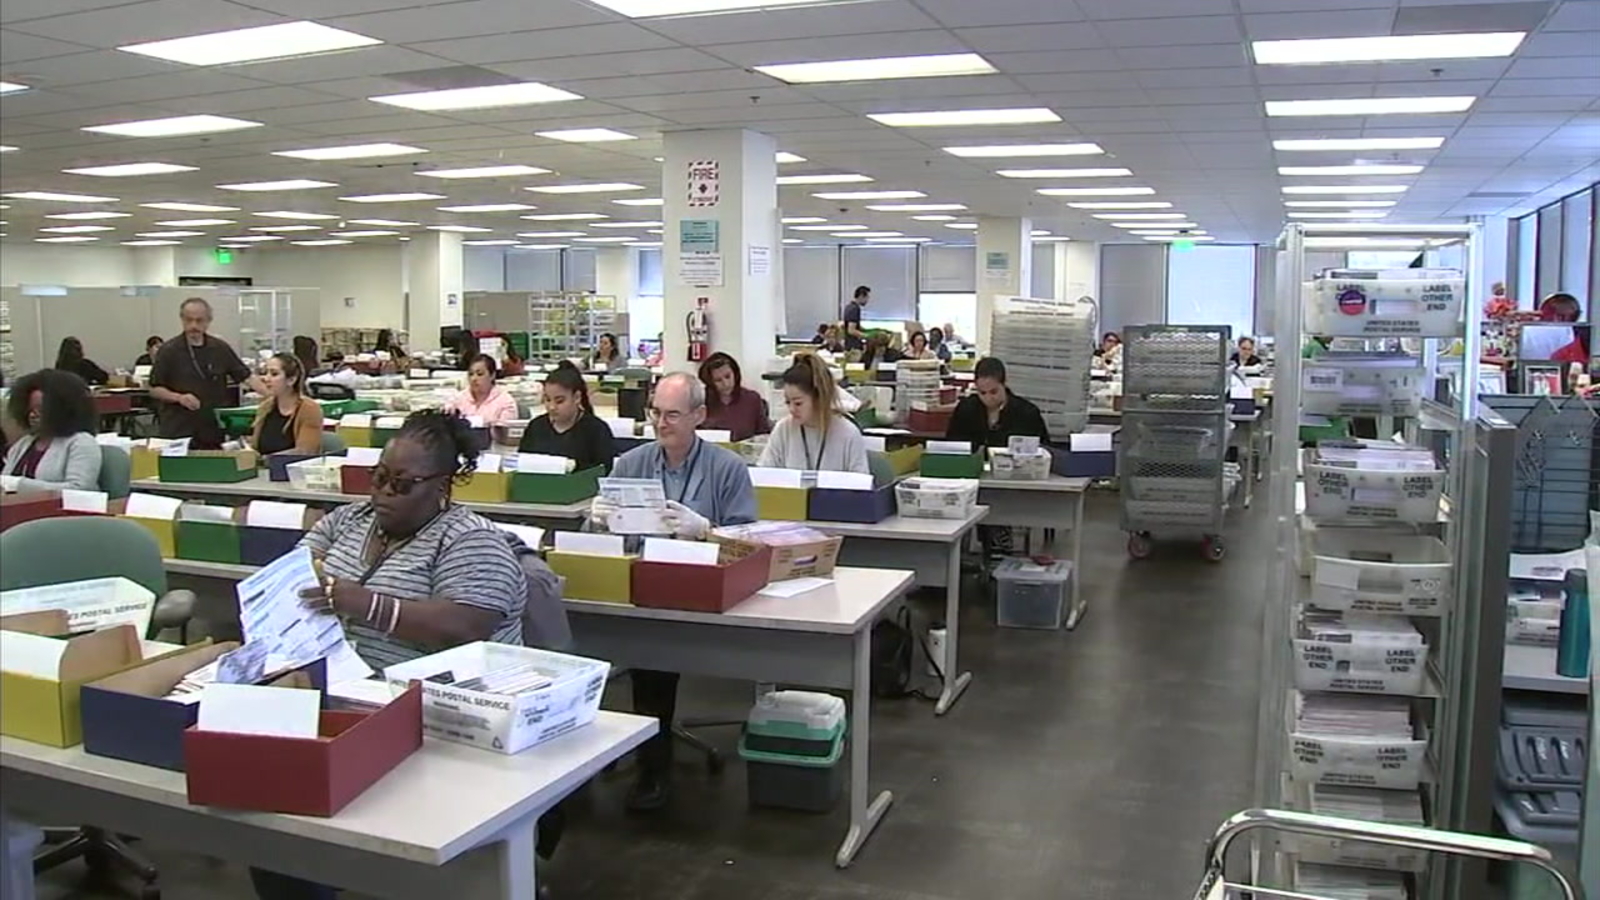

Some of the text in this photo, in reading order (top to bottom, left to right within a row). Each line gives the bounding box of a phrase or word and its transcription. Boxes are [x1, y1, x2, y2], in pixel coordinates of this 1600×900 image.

[1422, 284, 1452, 293] LABEL
[1421, 293, 1453, 302] OTHER
[1427, 303, 1447, 311] END
[1319, 471, 1348, 482] LABEL
[1403, 476, 1432, 484] LABEL
[80, 608, 112, 618] POSTAL
[114, 603, 147, 613] SERVICE
[1304, 646, 1333, 654] LABEL
[1303, 654, 1333, 662] OTHER
[442, 691, 472, 704] POSTAL
[473, 698, 511, 711] SERVICE
[1378, 747, 1407, 755] LABEL
